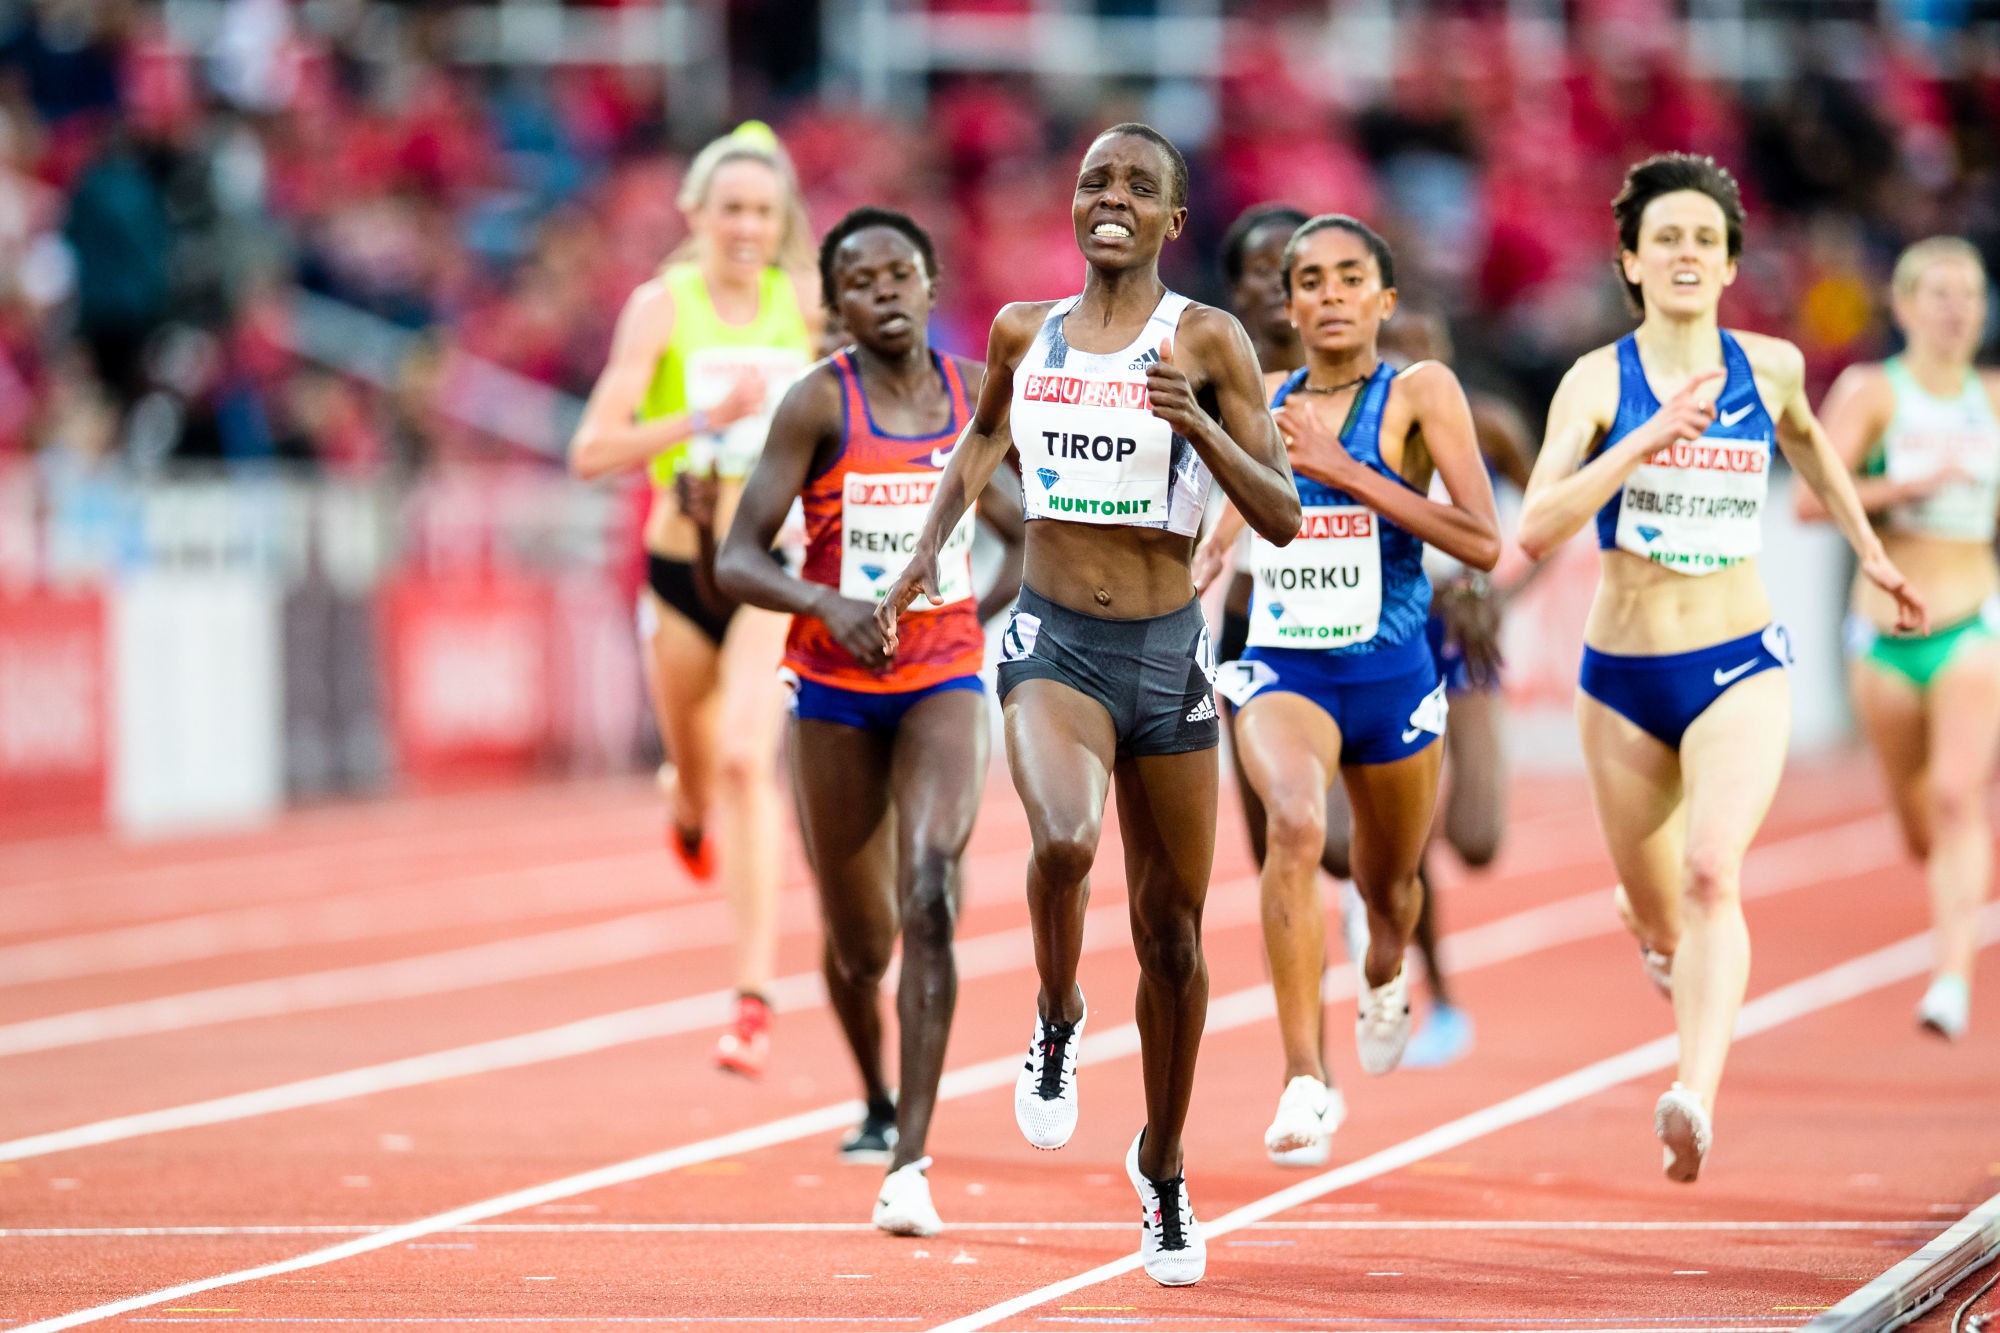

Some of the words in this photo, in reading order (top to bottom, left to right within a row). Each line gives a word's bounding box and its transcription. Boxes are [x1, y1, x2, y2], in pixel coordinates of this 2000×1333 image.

[1024, 374, 1153, 410] BAUHAU
[1042, 431, 1137, 462] TIROP
[1643, 443, 1766, 474] AUHAUS
[1048, 494, 1152, 516] HUNTONIT
[1261, 565, 1361, 590] WORKU
[1278, 625, 1362, 638] HUNTONIT
[1186, 708, 1215, 722] adidas
